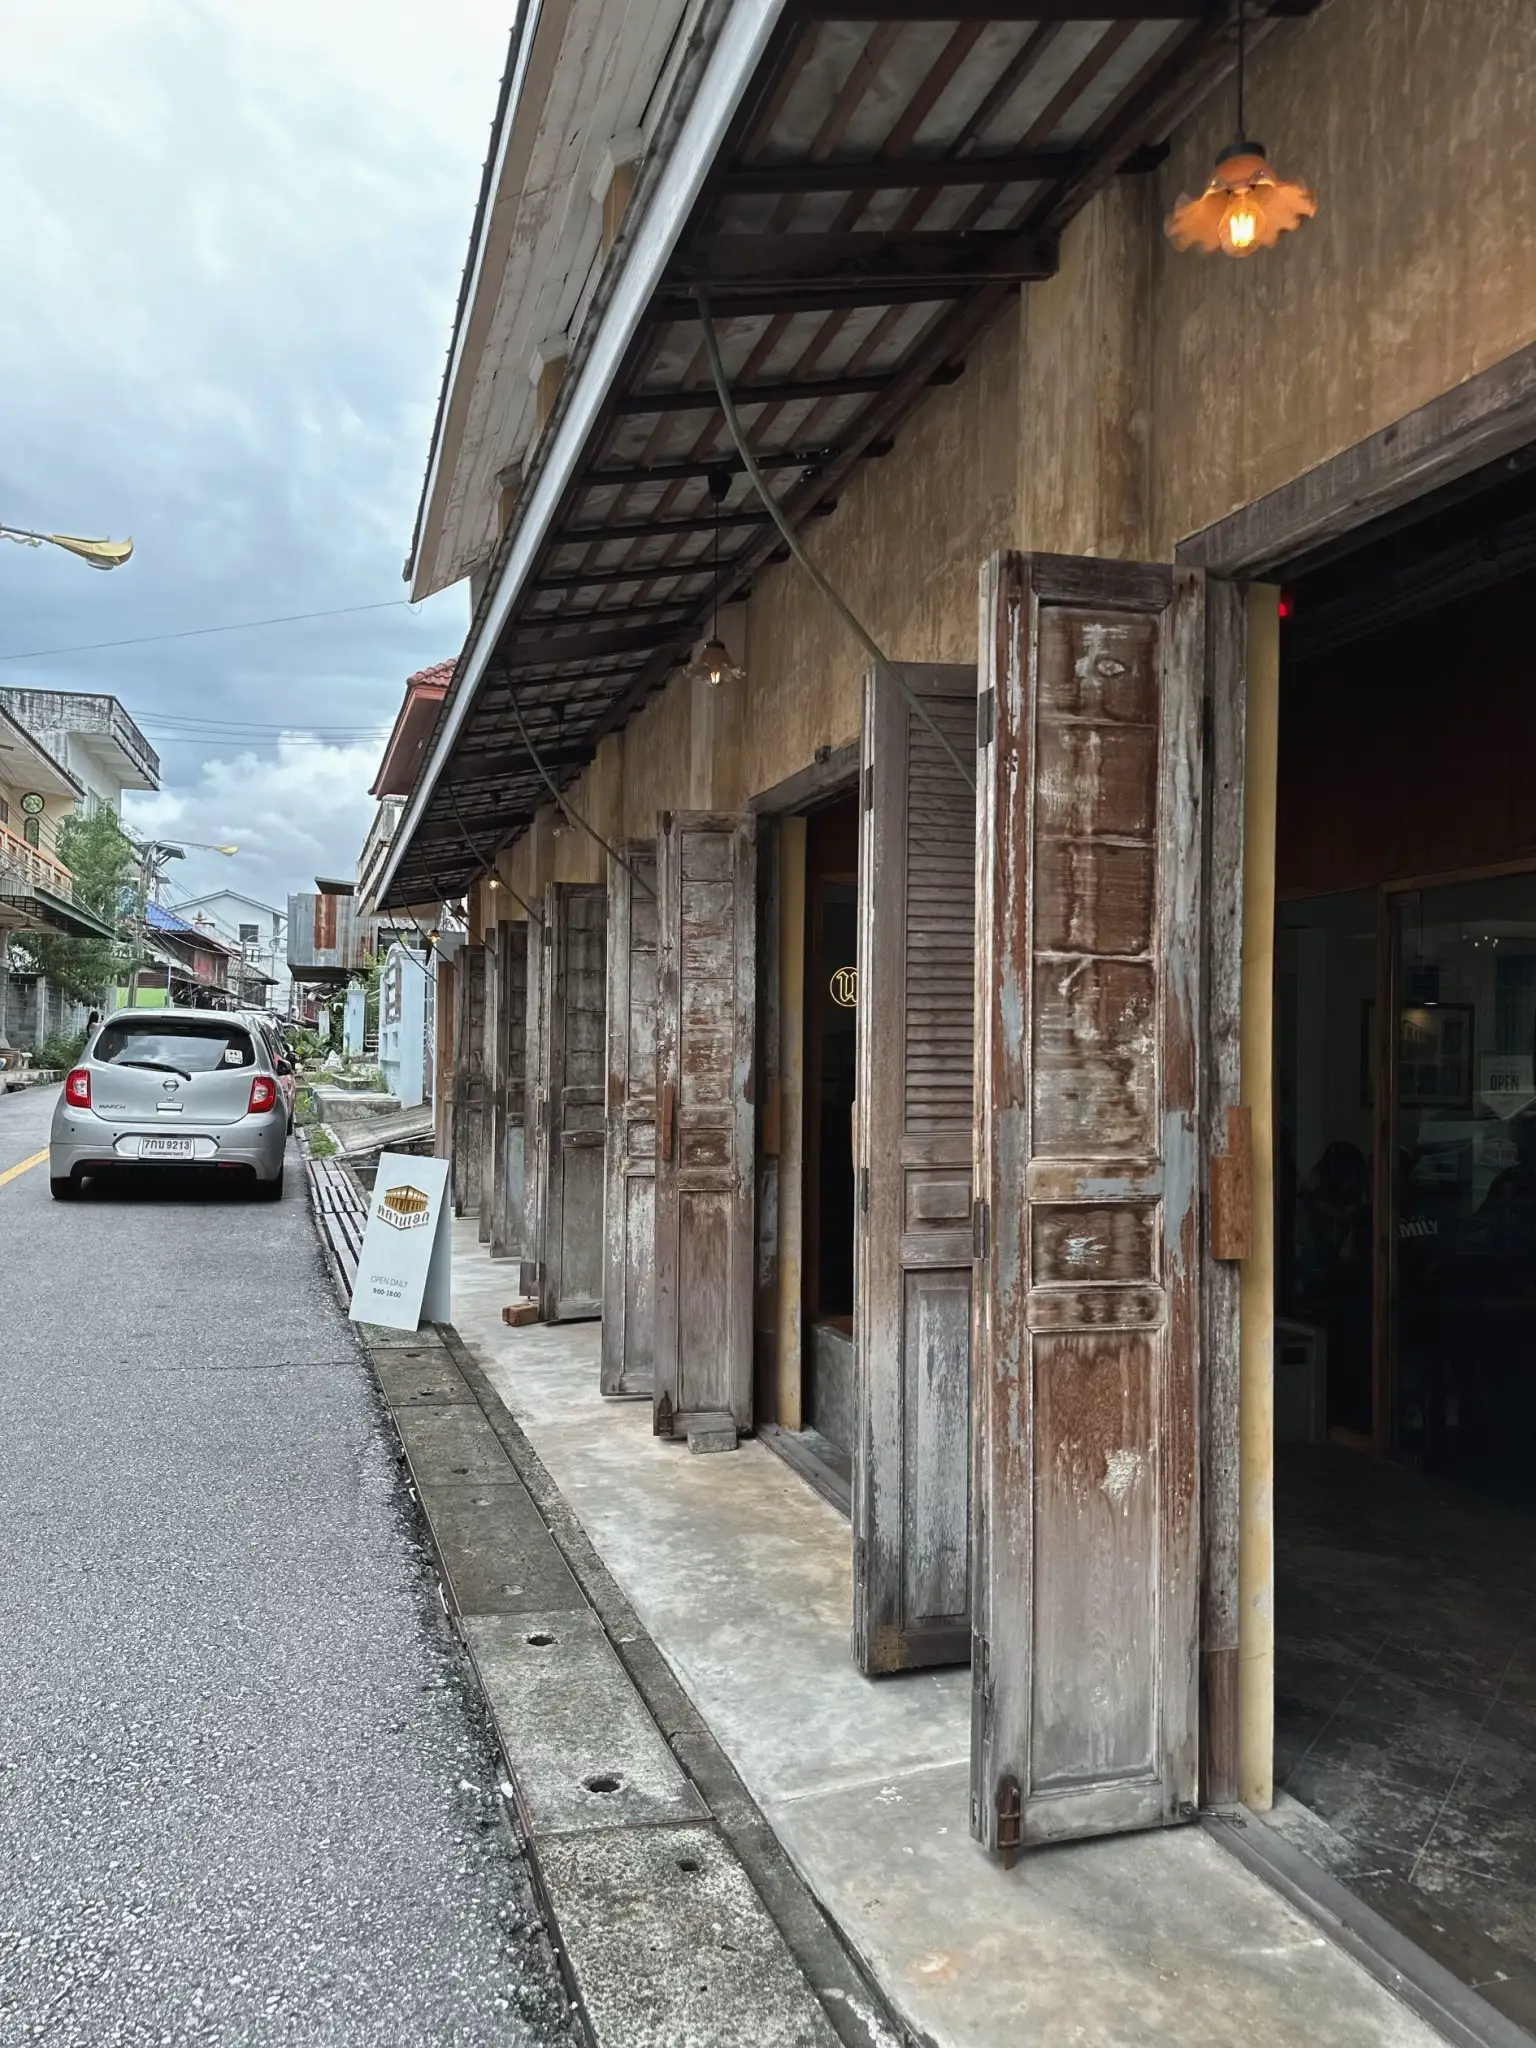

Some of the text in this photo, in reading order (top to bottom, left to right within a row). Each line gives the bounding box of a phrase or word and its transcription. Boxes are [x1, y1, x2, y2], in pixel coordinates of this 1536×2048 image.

[1490, 1074, 1519, 1091] OPEN
[166, 1140, 190, 1150] 9213
[1397, 1220, 1439, 1239] MILY
[370, 1275, 409, 1288] OPEN DAILY
